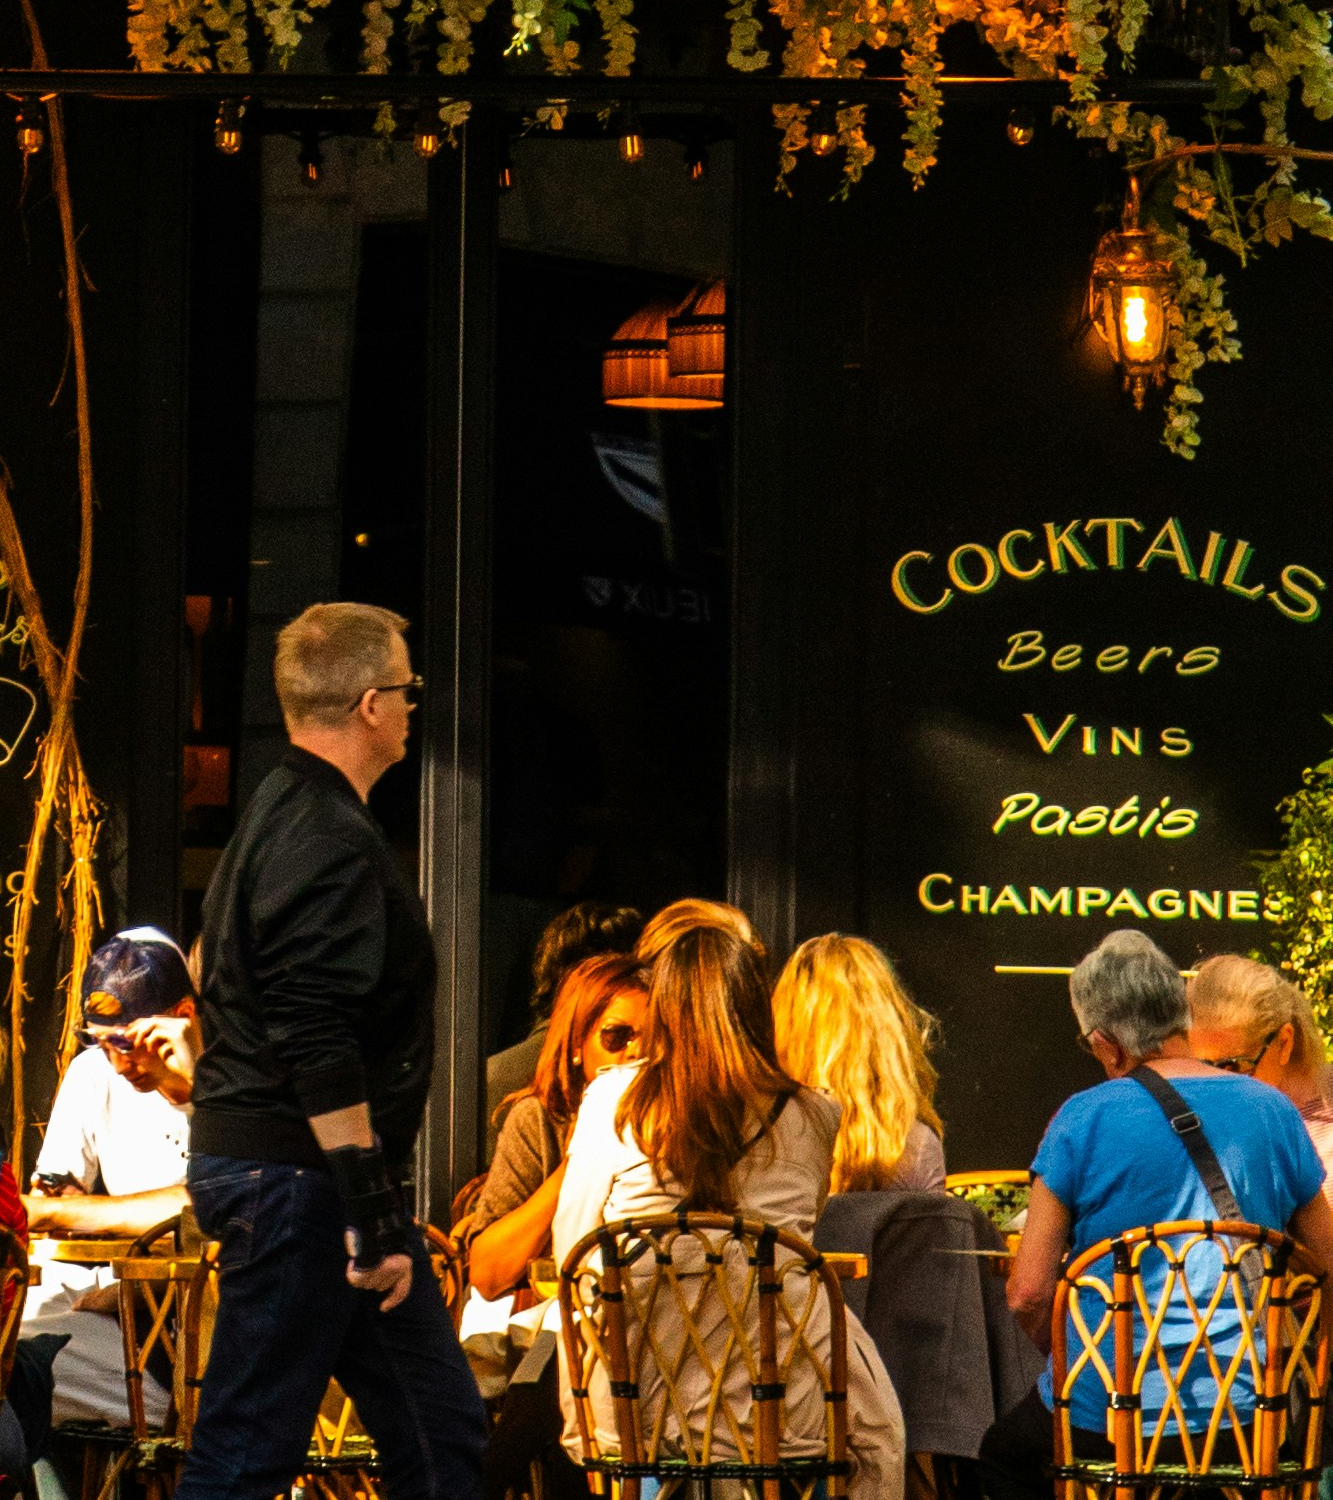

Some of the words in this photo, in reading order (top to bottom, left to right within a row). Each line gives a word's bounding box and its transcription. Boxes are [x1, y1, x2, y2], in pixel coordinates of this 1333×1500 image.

[890, 516, 1327, 624] COCKTAILS
[997, 629, 1222, 676] Beers
[992, 791, 1200, 839] Pastis
